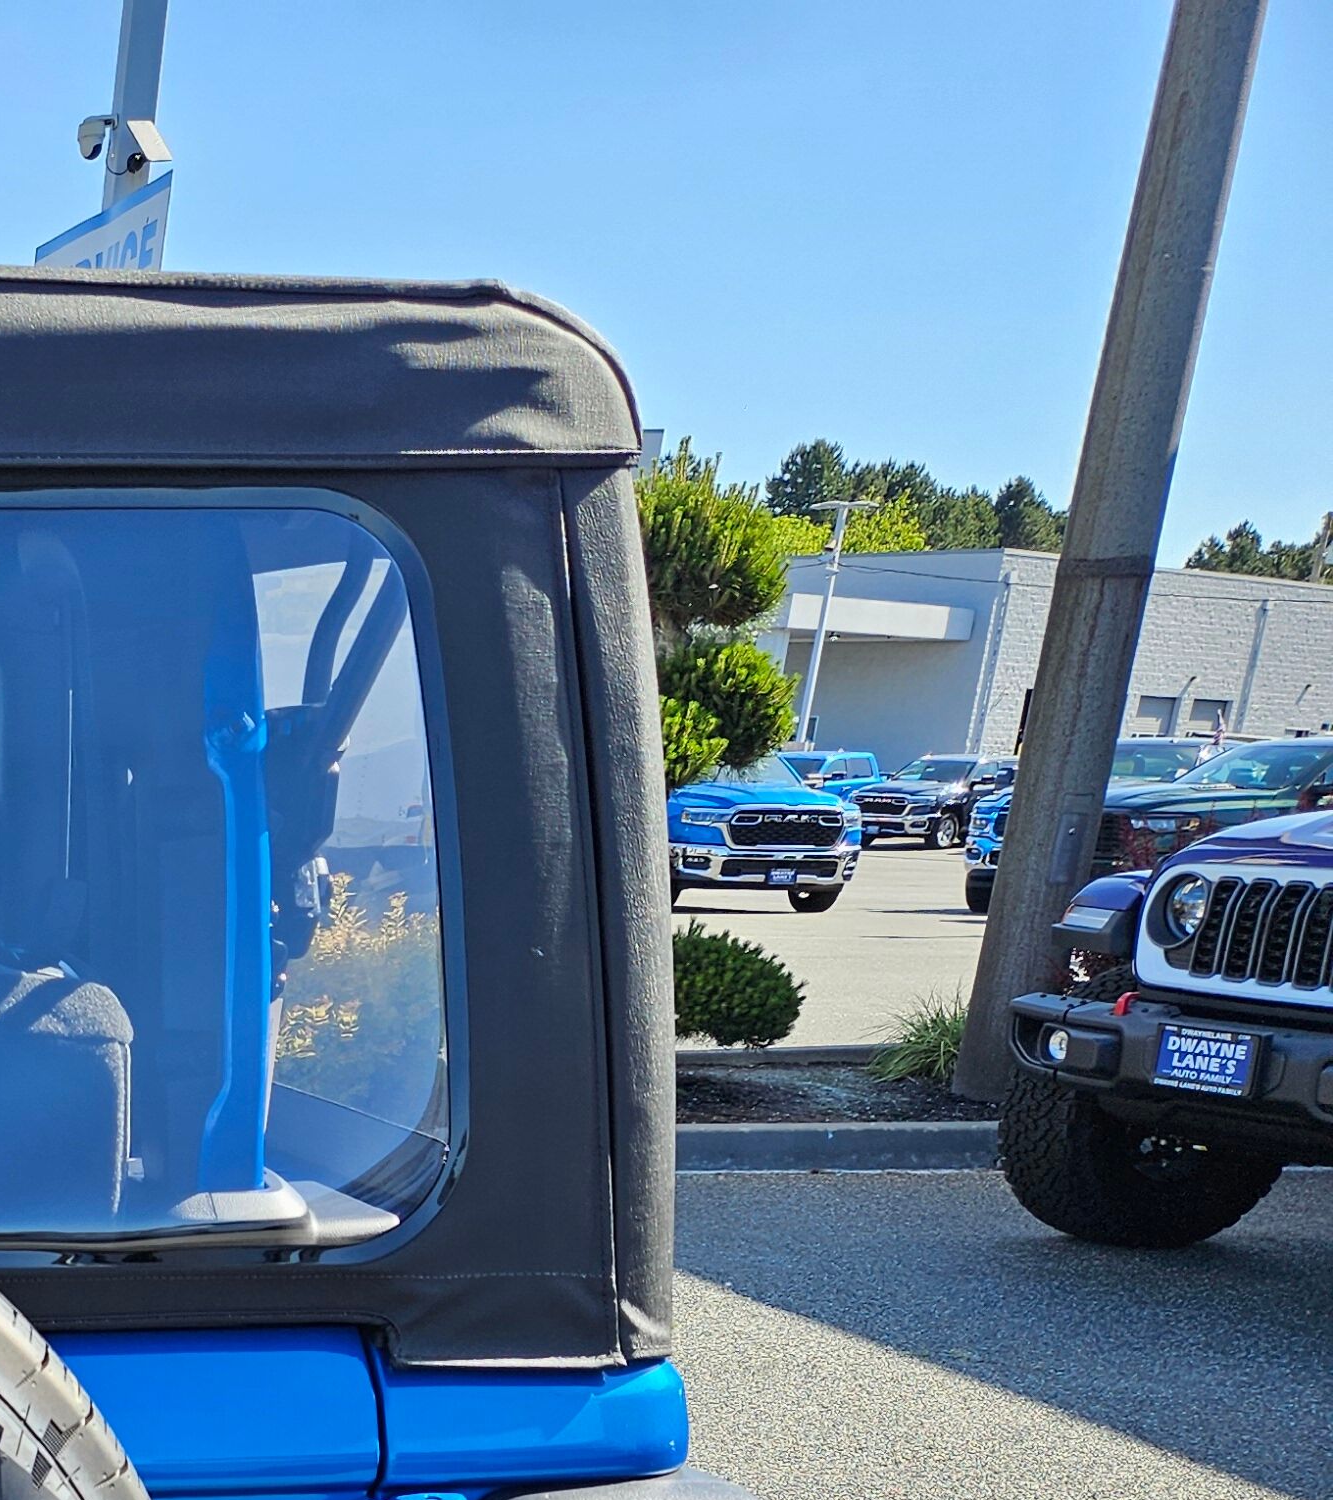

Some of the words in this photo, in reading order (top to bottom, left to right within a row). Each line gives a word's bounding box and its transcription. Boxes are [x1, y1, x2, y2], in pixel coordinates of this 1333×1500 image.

[1167, 1036, 1248, 1060] DWAYNE
[1171, 1052, 1237, 1075] LANE'S
[1171, 1068, 1198, 1080] AUTO
[1199, 1072, 1233, 1084] FAMILY
